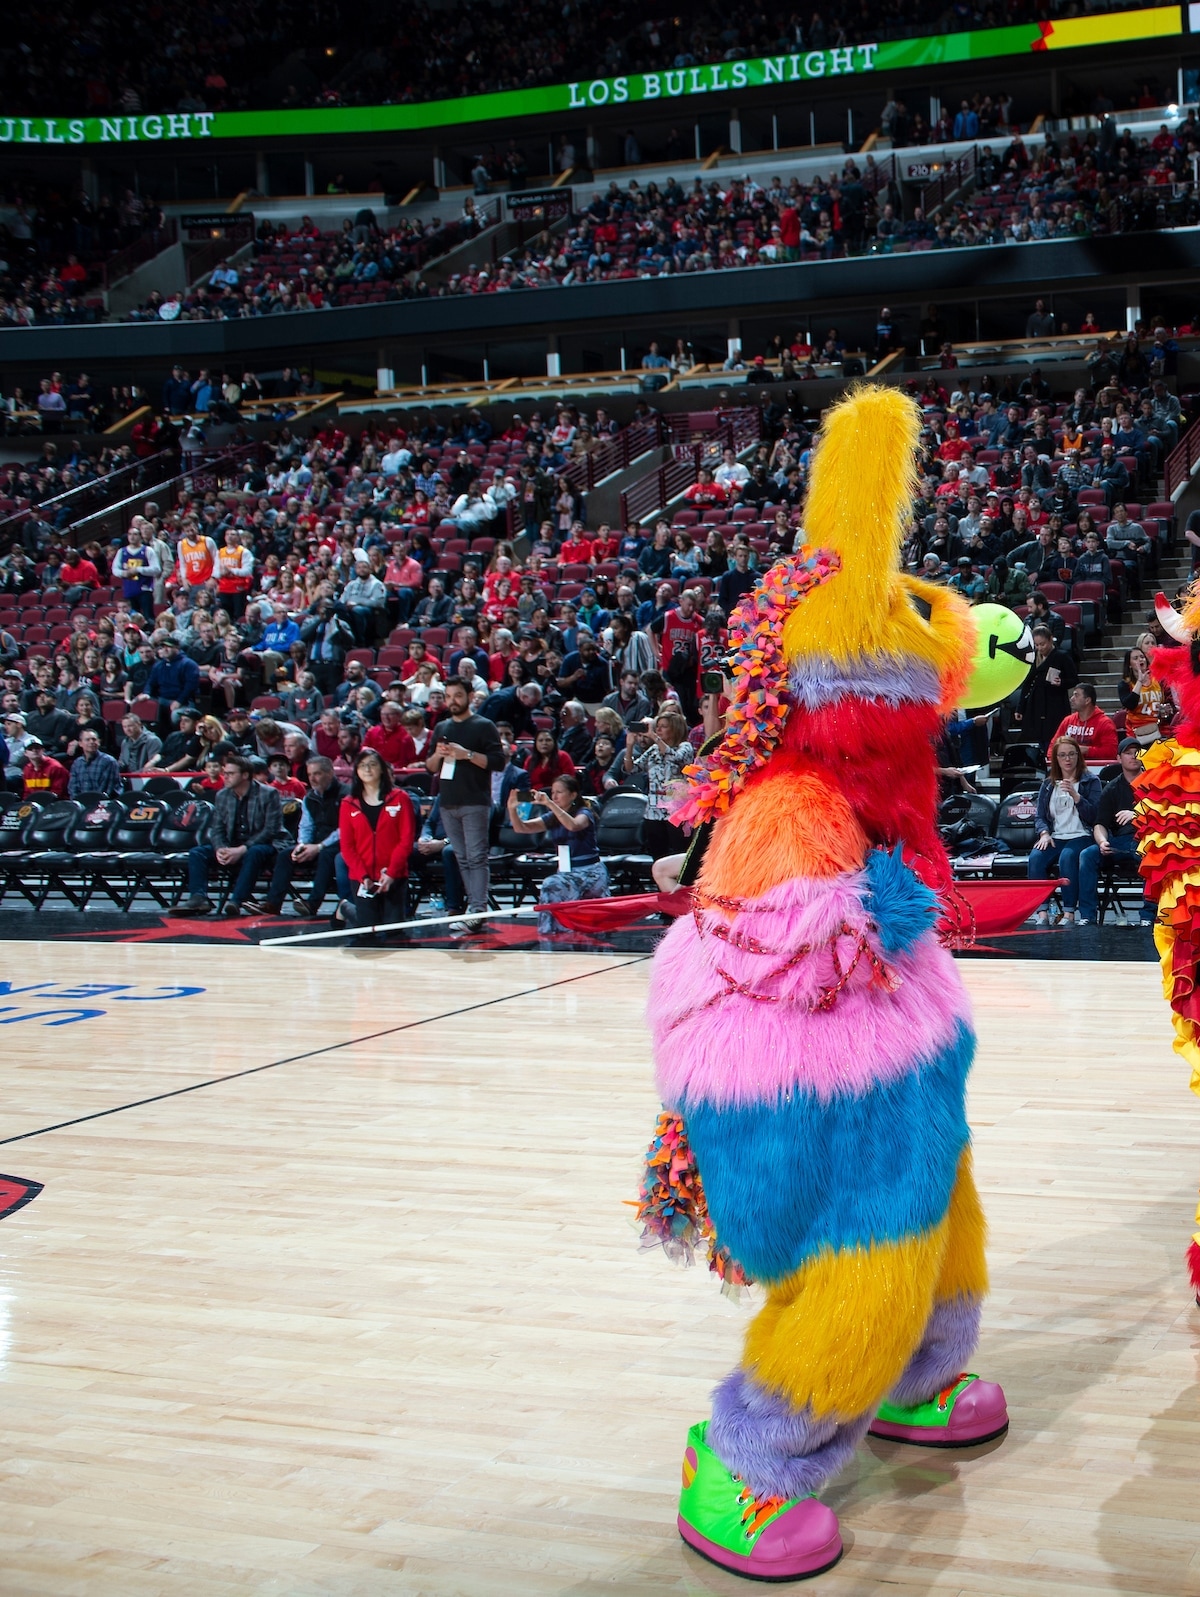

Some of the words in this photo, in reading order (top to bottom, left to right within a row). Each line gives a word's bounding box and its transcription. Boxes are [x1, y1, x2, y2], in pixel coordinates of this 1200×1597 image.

[568, 77, 629, 108] LOS
[643, 62, 749, 99] BULLS
[763, 43, 878, 84] NIGHT
[99, 112, 214, 141] NIGHT
[184, 551, 207, 562] UTAH
[192, 562, 200, 572] 2
[700, 644, 725, 666] 23
[1071, 725, 1094, 736] BULLS
